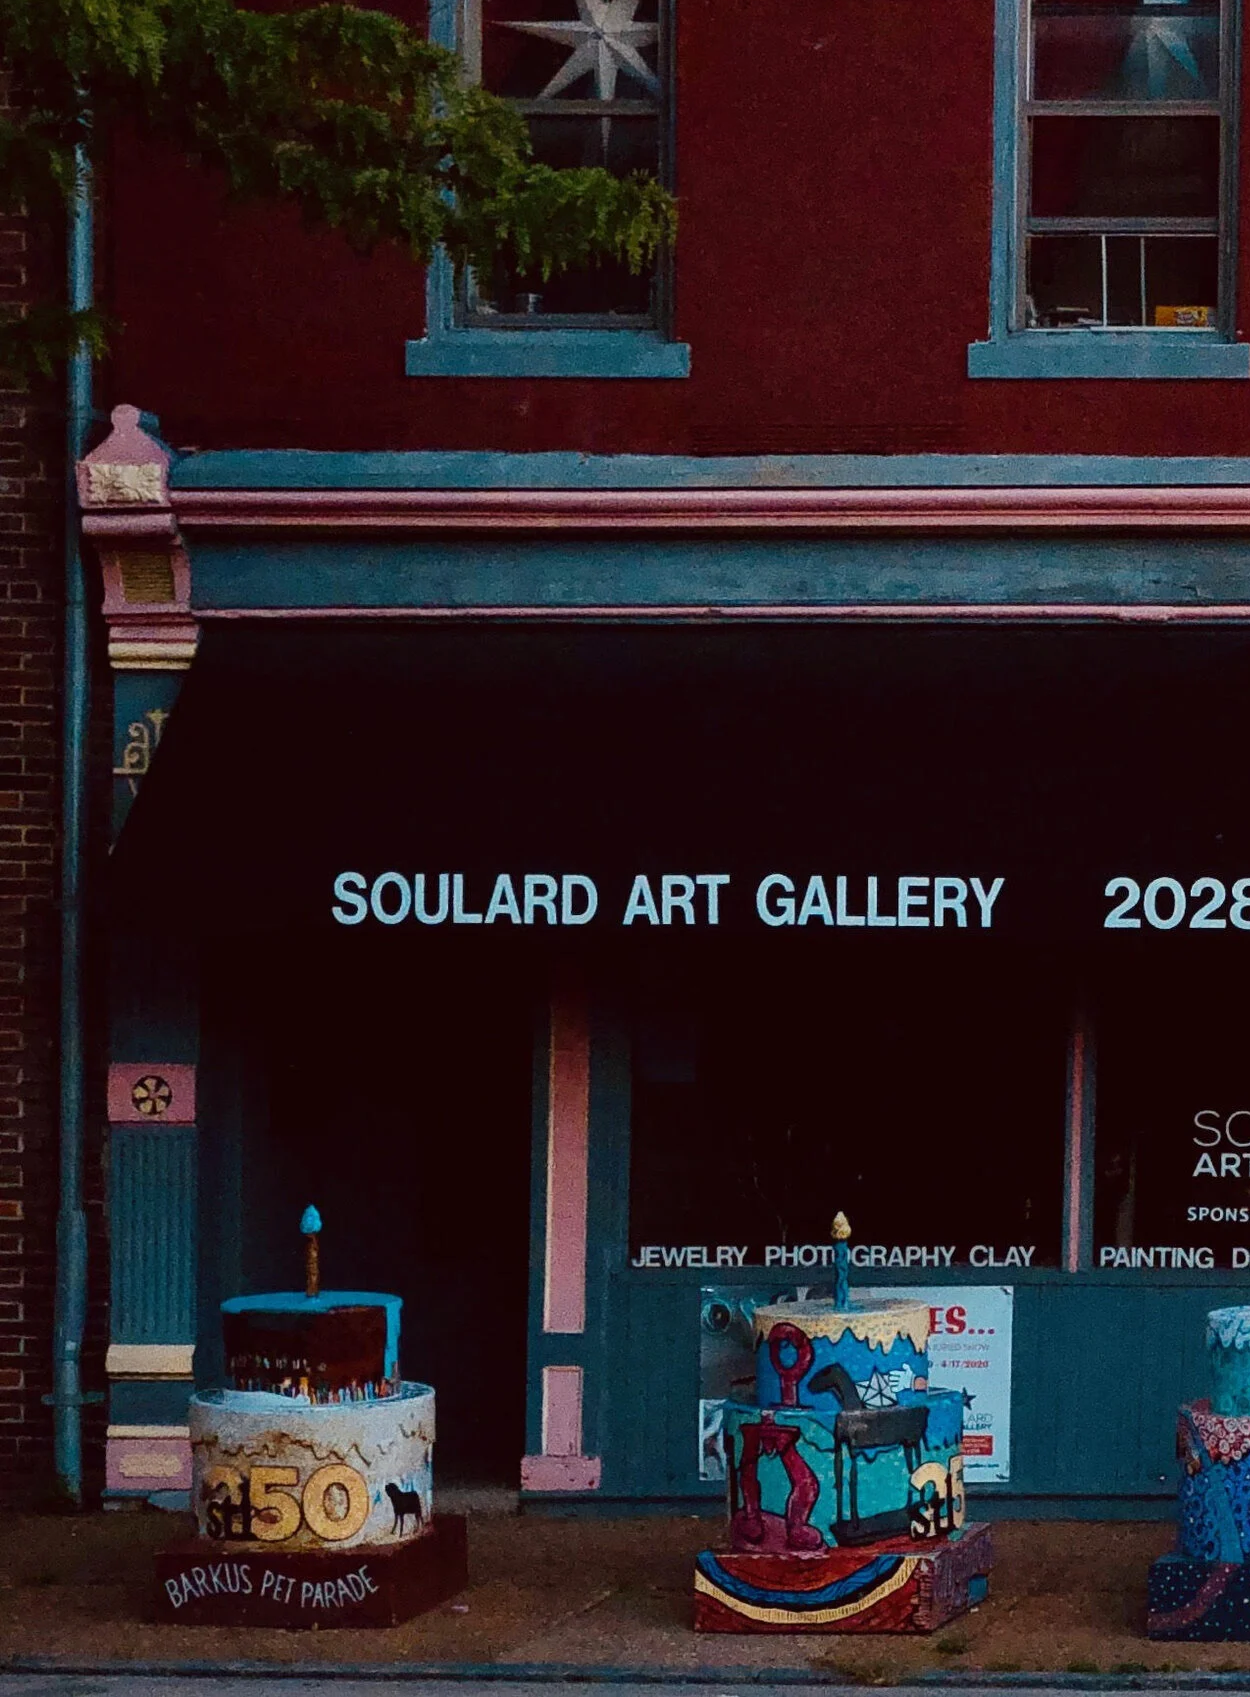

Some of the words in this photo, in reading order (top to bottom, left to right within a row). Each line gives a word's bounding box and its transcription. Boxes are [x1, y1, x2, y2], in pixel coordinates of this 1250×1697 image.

[332, 872, 597, 925] SOULARD
[623, 875, 730, 925] ART
[756, 874, 1005, 927] GALLERY
[632, 1246, 748, 1267] JEWELRY
[765, 1245, 956, 1268] PHOTGRAPHY
[969, 1246, 1036, 1267] CLAY
[1100, 1247, 1214, 1269] PAINTING
[165, 1563, 253, 1608] BARKUS
[261, 1570, 296, 1604] PET
[301, 1565, 379, 1608] PARADE
